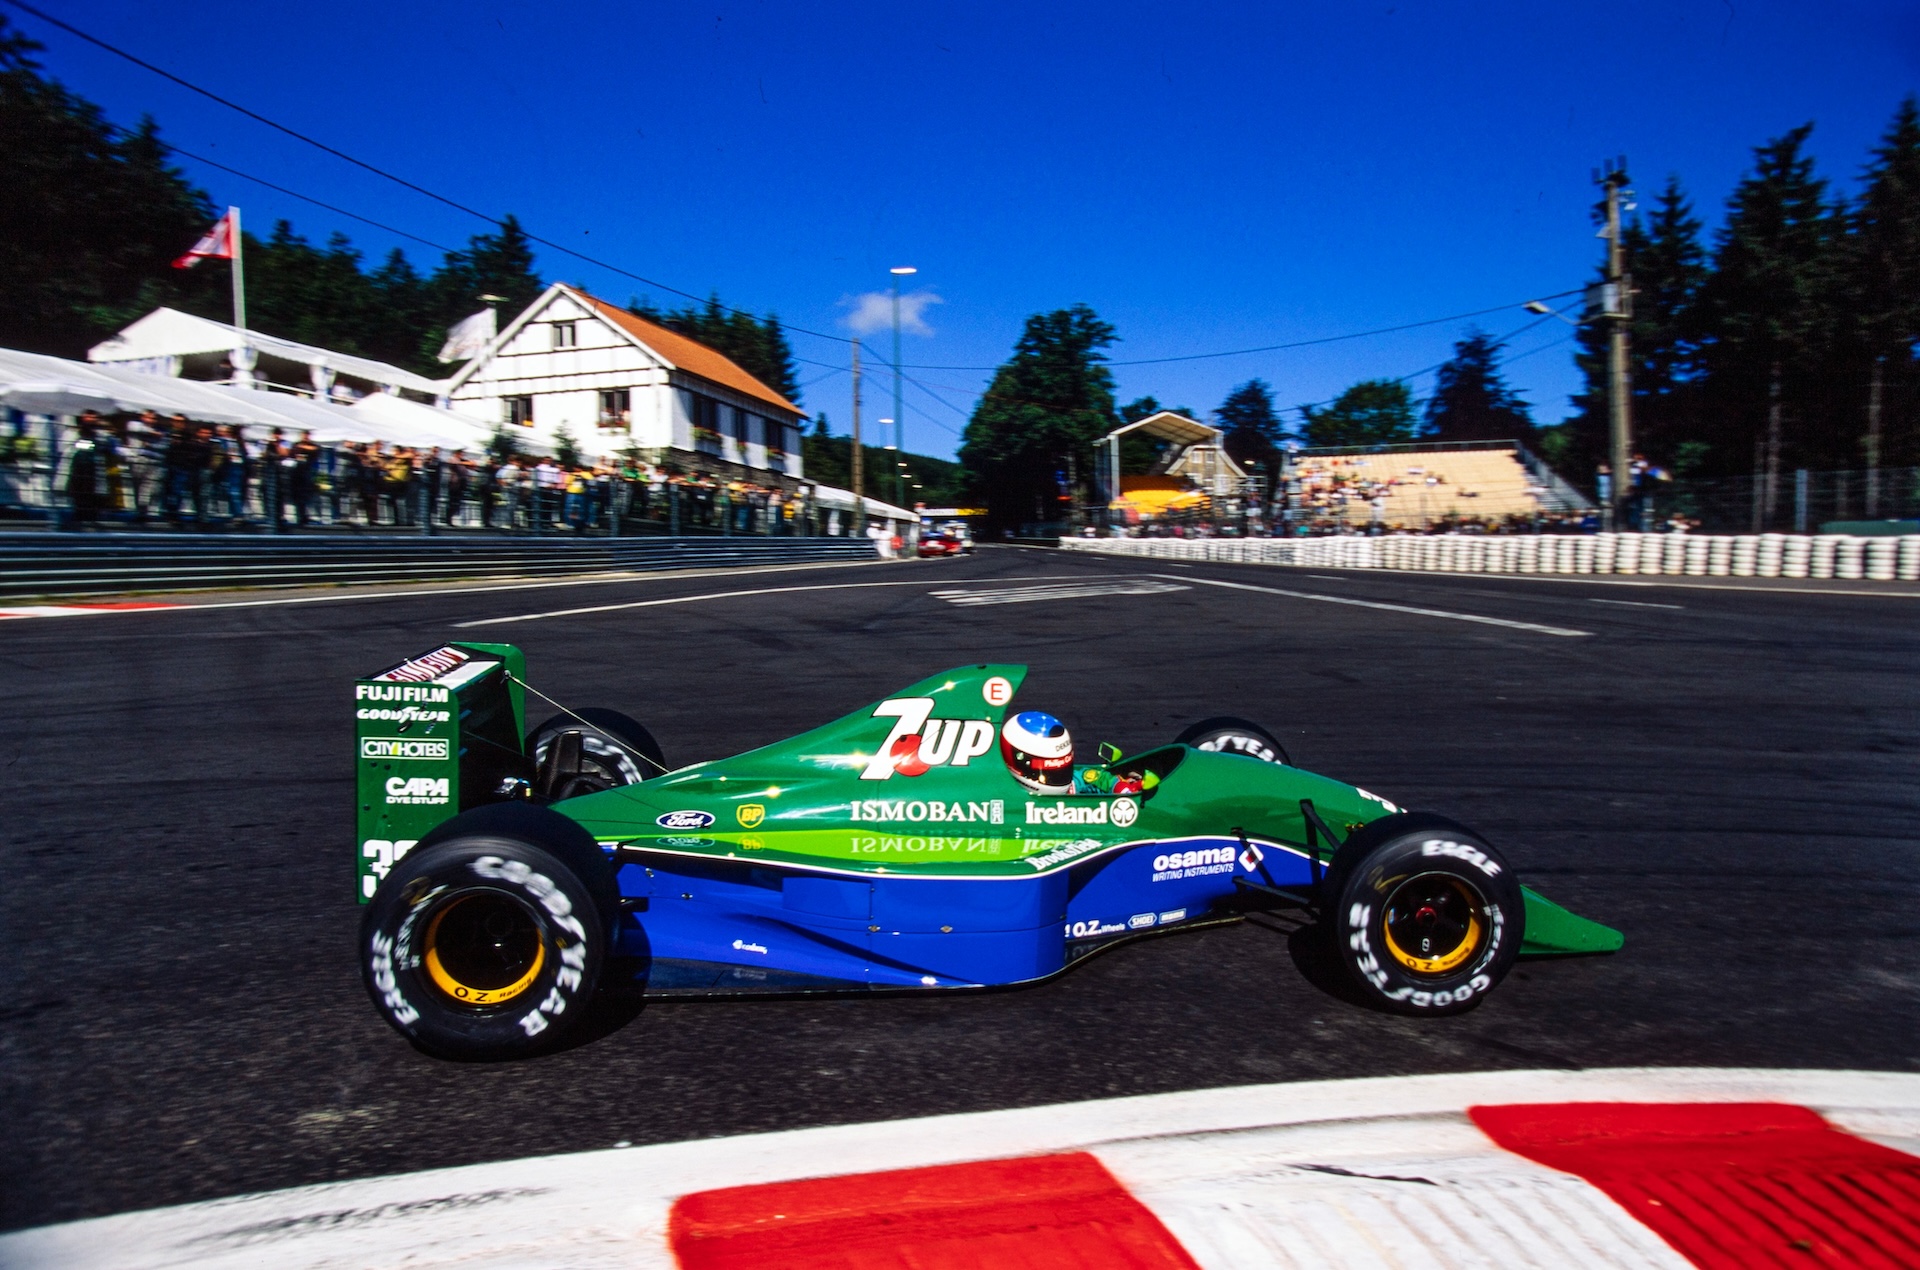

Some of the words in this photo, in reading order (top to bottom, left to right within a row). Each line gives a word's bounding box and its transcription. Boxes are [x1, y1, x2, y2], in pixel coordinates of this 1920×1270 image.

[356, 685, 449, 702] FUJIFILM
[991, 683, 1003, 700] E
[356, 706, 450, 723] GOODYEAR
[859, 697, 995, 780] 7UP
[364, 741, 393, 756] CITY
[398, 742, 446, 757] HOTELS
[385, 777, 449, 796] CAPA
[667, 812, 704, 826] Ford
[742, 808, 762, 821] BP
[850, 801, 990, 822] ISMOBAN
[1025, 802, 1108, 824] Ireland
[1153, 846, 1236, 871] osama
[1152, 869, 1183, 882] WRITING
[1183, 863, 1234, 878] INSTRUMENTS
